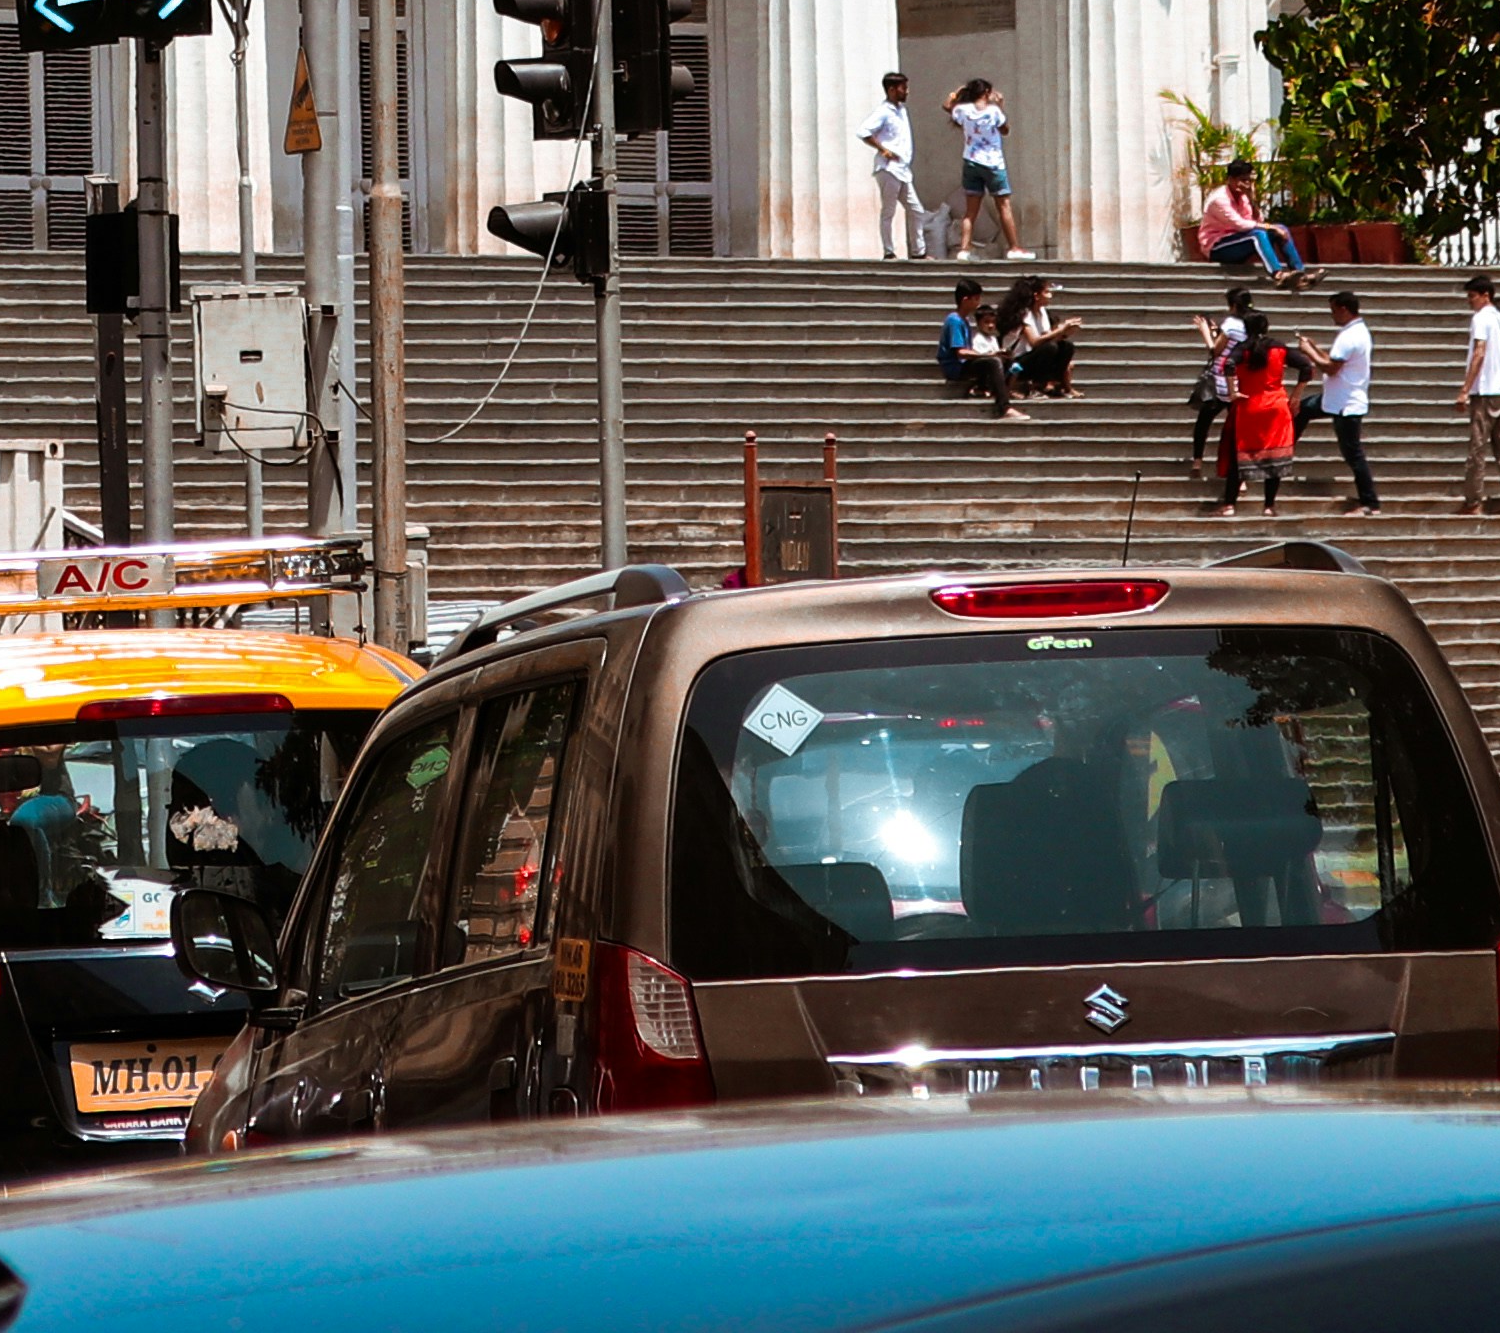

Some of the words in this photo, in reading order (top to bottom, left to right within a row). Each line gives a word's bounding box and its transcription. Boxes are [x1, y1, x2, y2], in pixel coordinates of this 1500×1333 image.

[53, 560, 150, 595] A/C
[1027, 636, 1093, 650] Green
[760, 709, 808, 730] CNG
